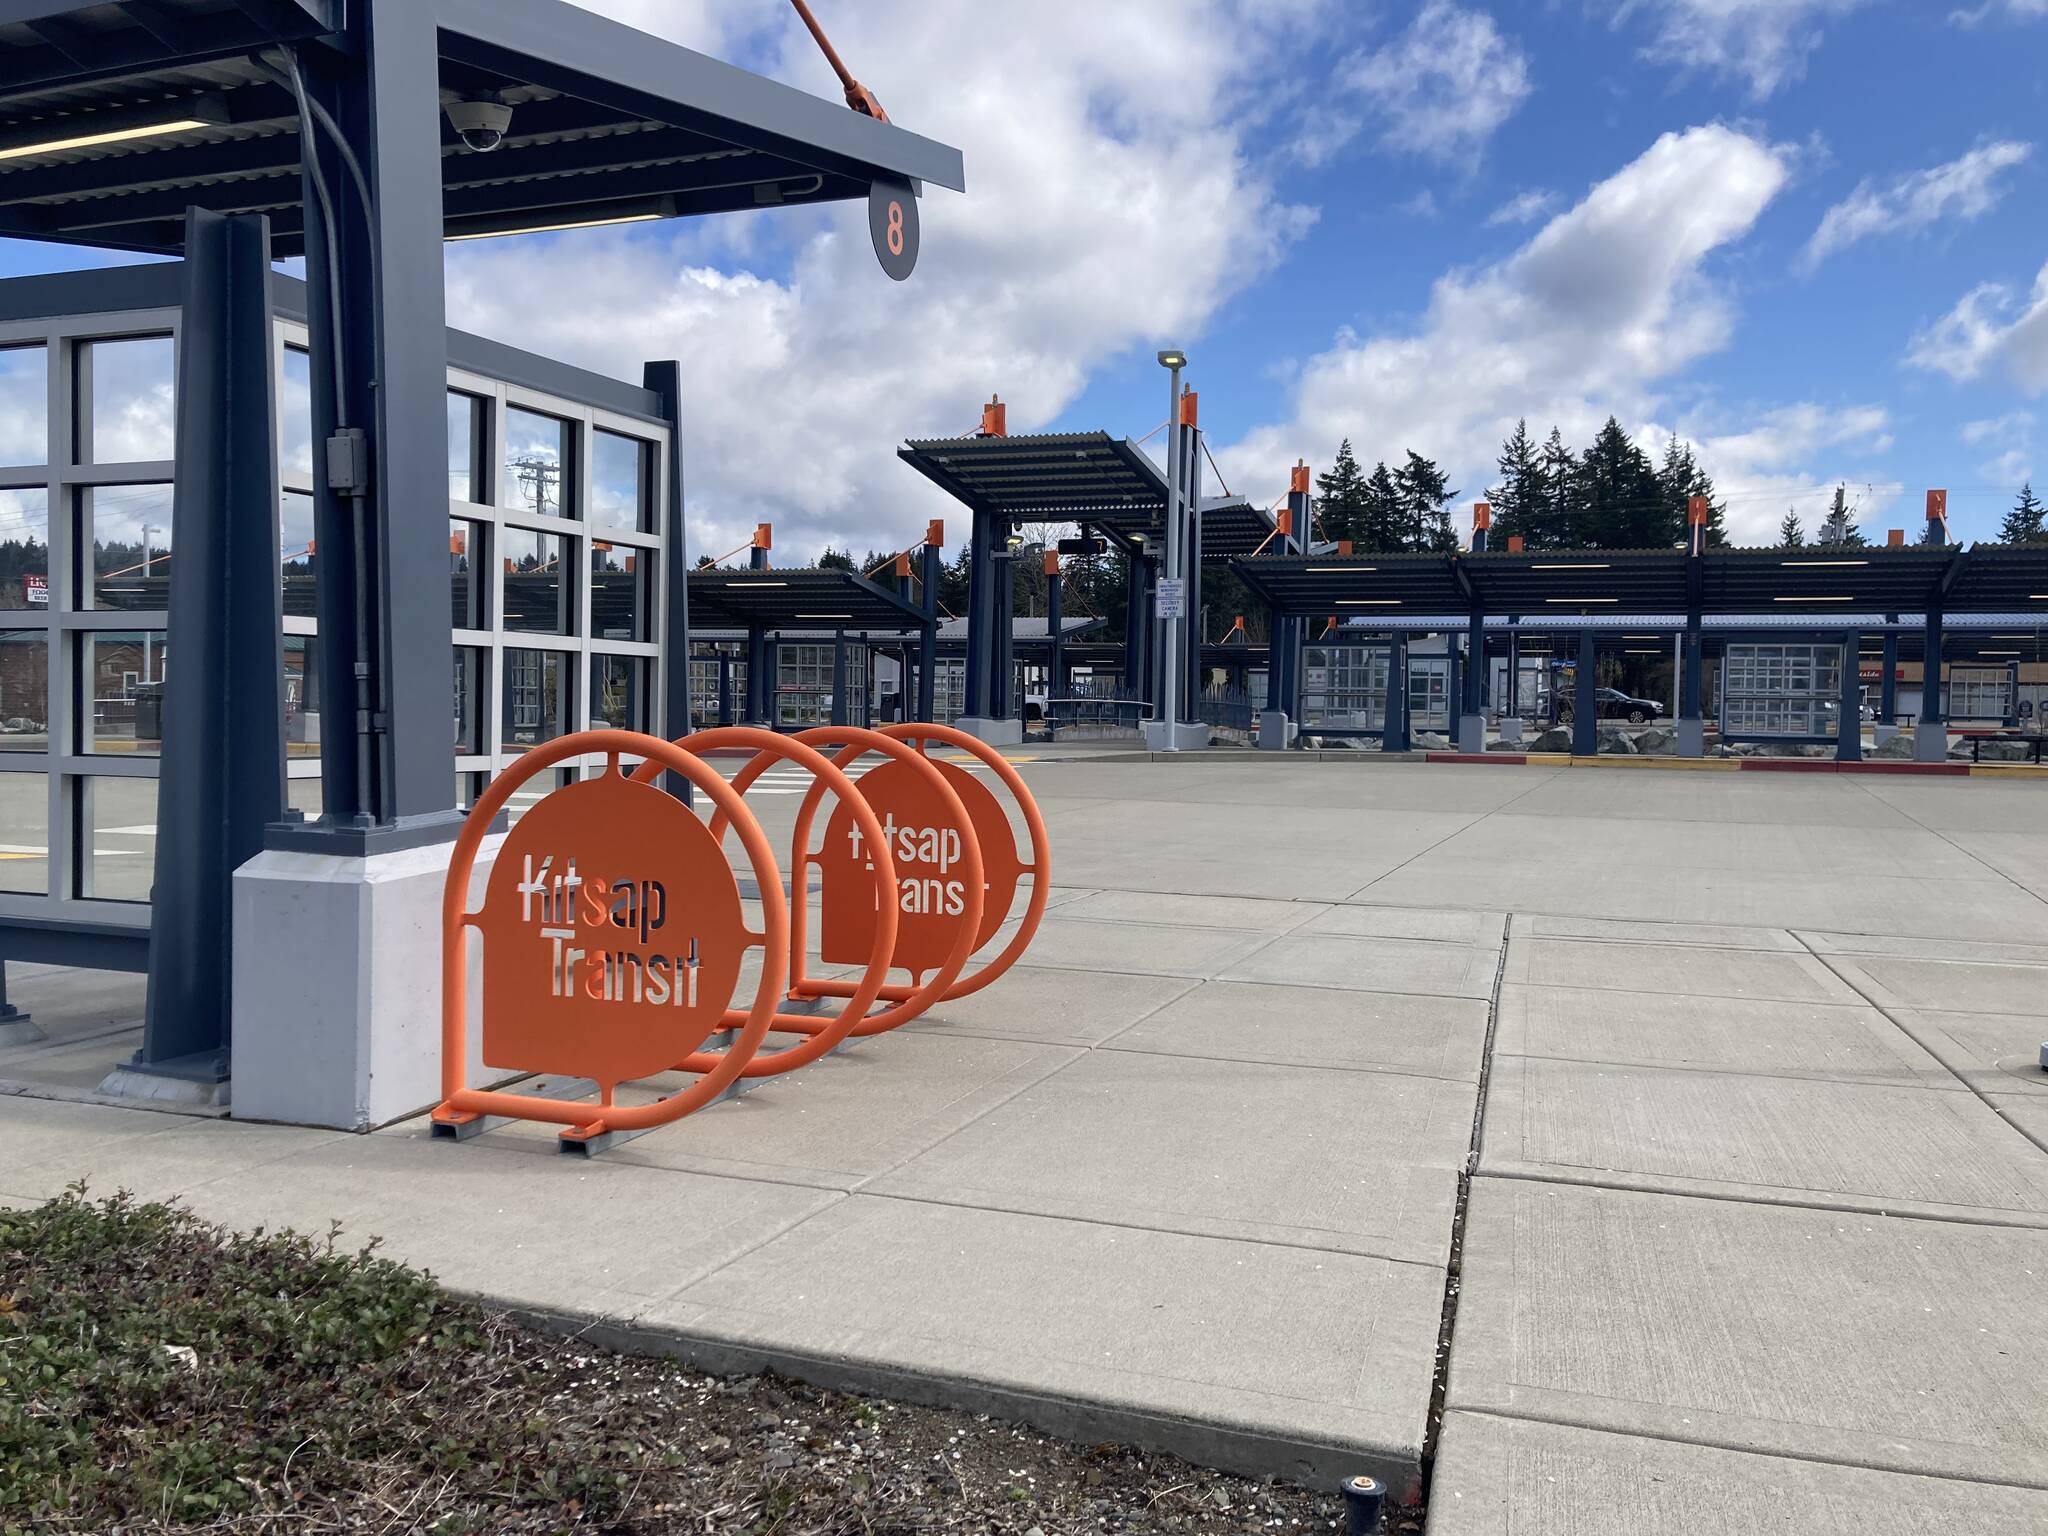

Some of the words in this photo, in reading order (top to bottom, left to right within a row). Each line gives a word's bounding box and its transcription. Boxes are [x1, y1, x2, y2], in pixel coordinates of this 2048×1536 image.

[887, 200, 904, 256] 8
[1097, 541, 1102, 551] 7
[517, 855, 666, 945] Kitsap
[540, 928, 704, 1008] Transit
